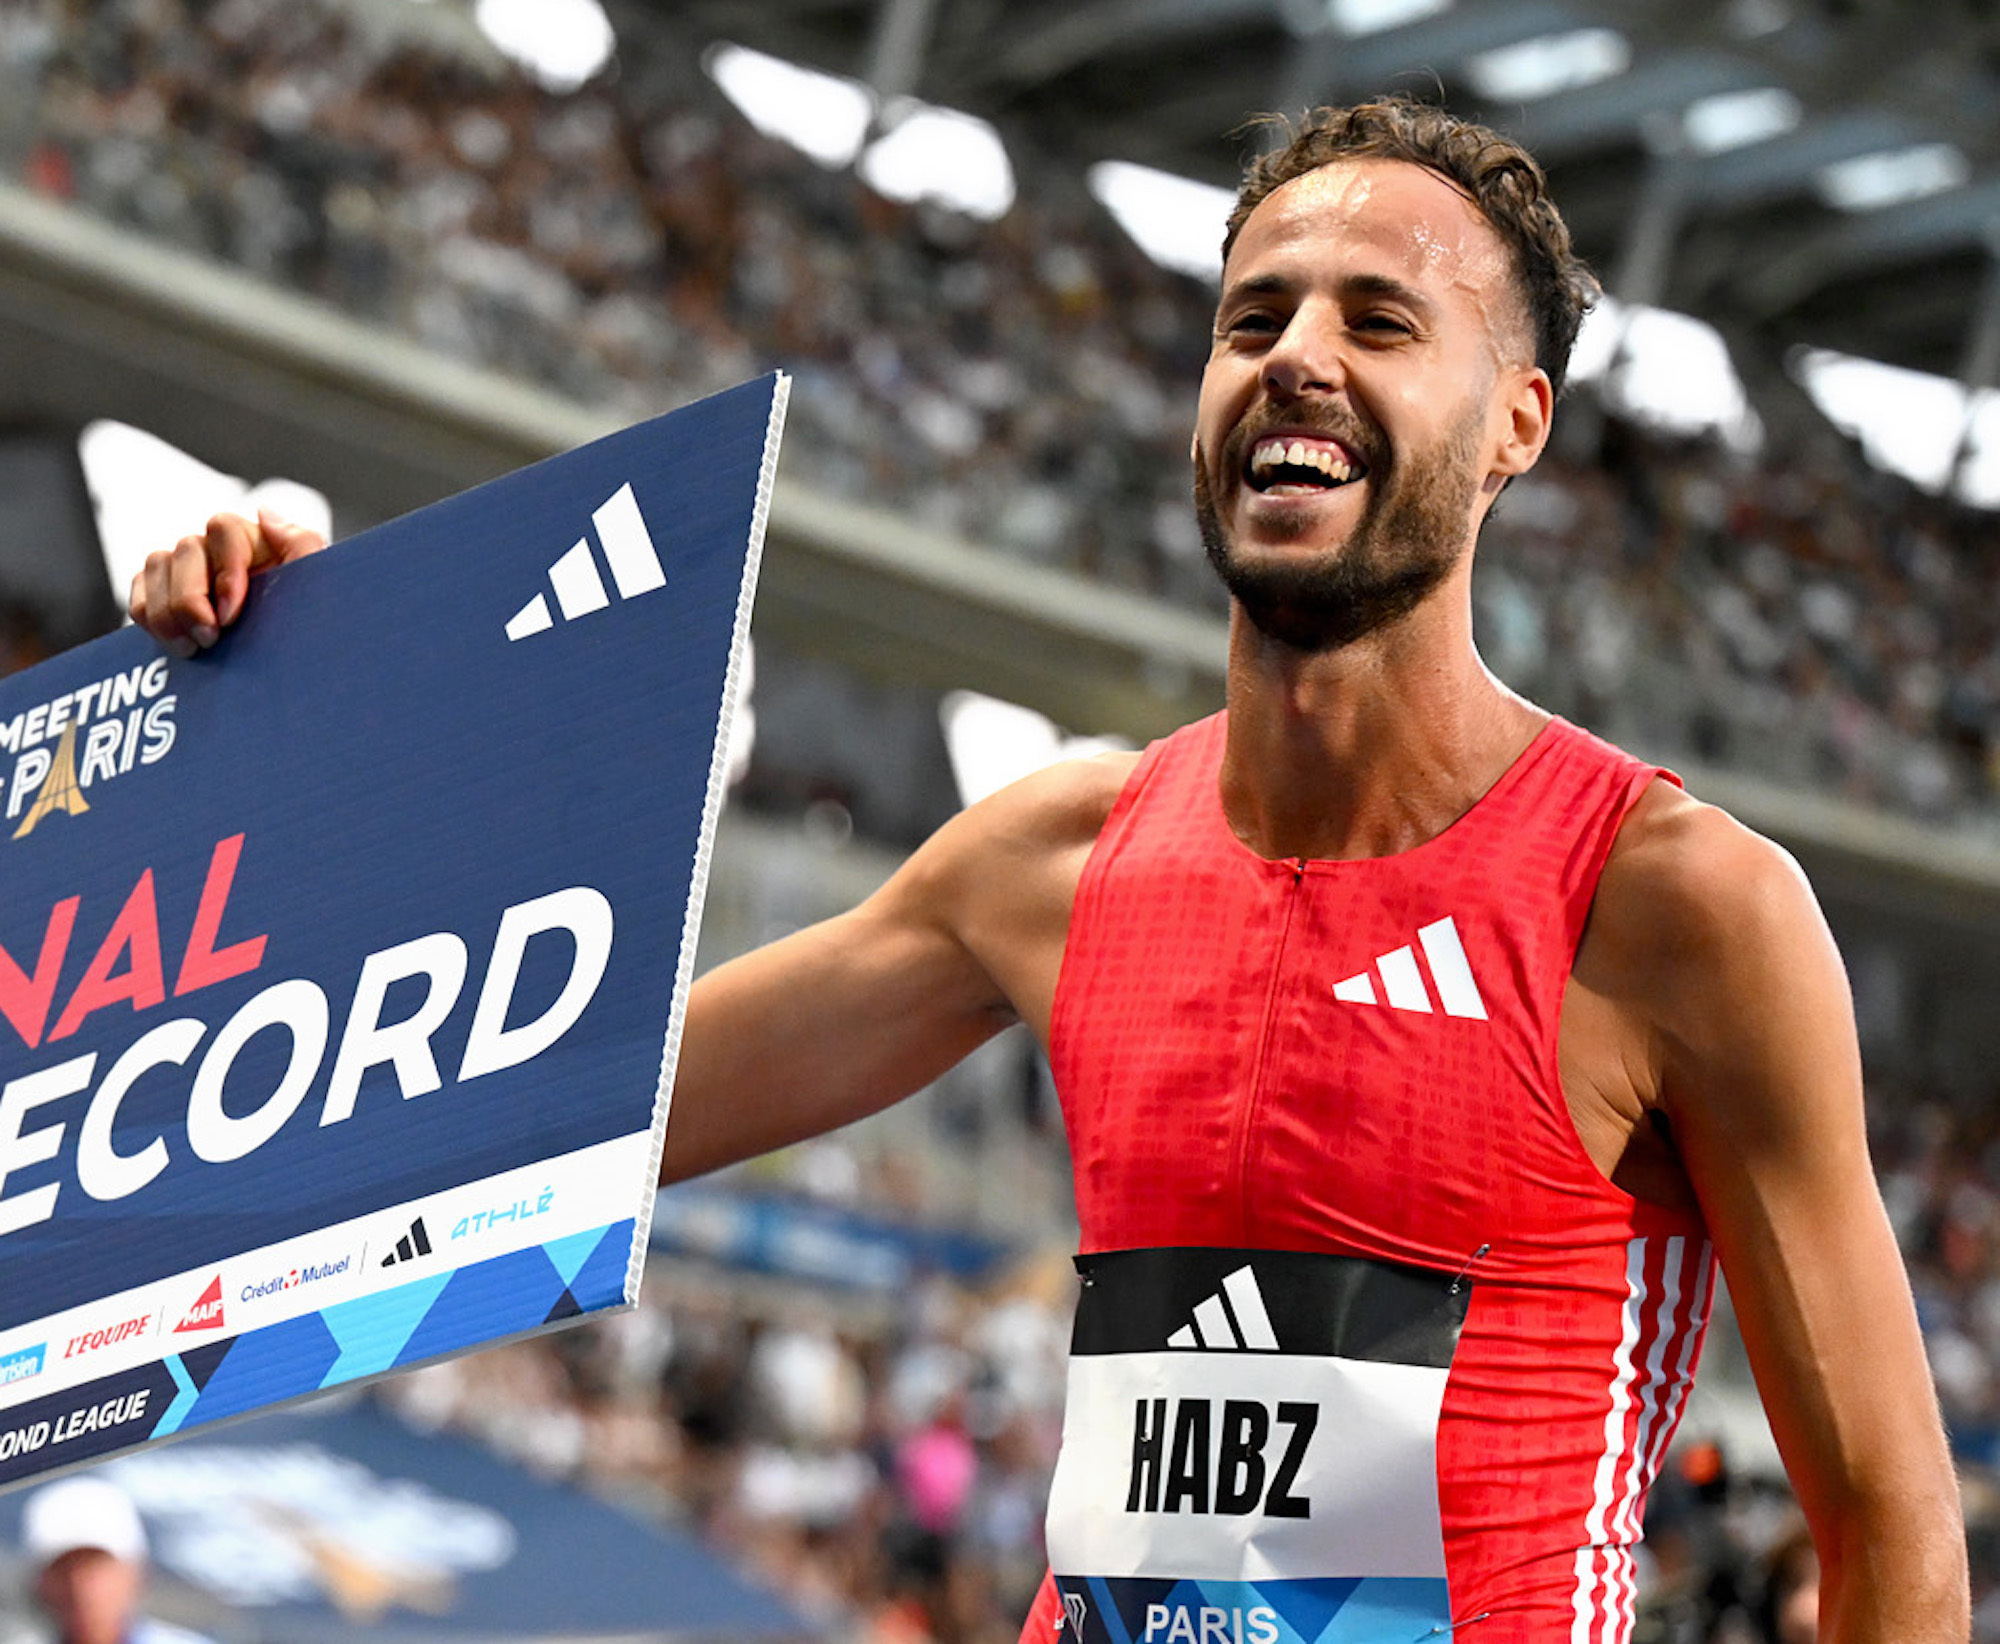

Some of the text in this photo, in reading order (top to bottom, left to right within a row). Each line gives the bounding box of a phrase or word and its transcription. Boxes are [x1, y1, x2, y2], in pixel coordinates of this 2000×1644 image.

[0, 656, 170, 754] MEETING
[6, 695, 177, 840] PARIS
[0, 886, 614, 1235] ECORD
[450, 1185, 555, 1241] ATHLÉ
[182, 1299, 224, 1327] MAIF
[241, 1254, 350, 1302] Crédit Mutuel
[0, 1388, 150, 1461] OND LEAGUE
[1125, 1397, 1320, 1520] HABZ
[1144, 1603, 1280, 1644] PARIS
